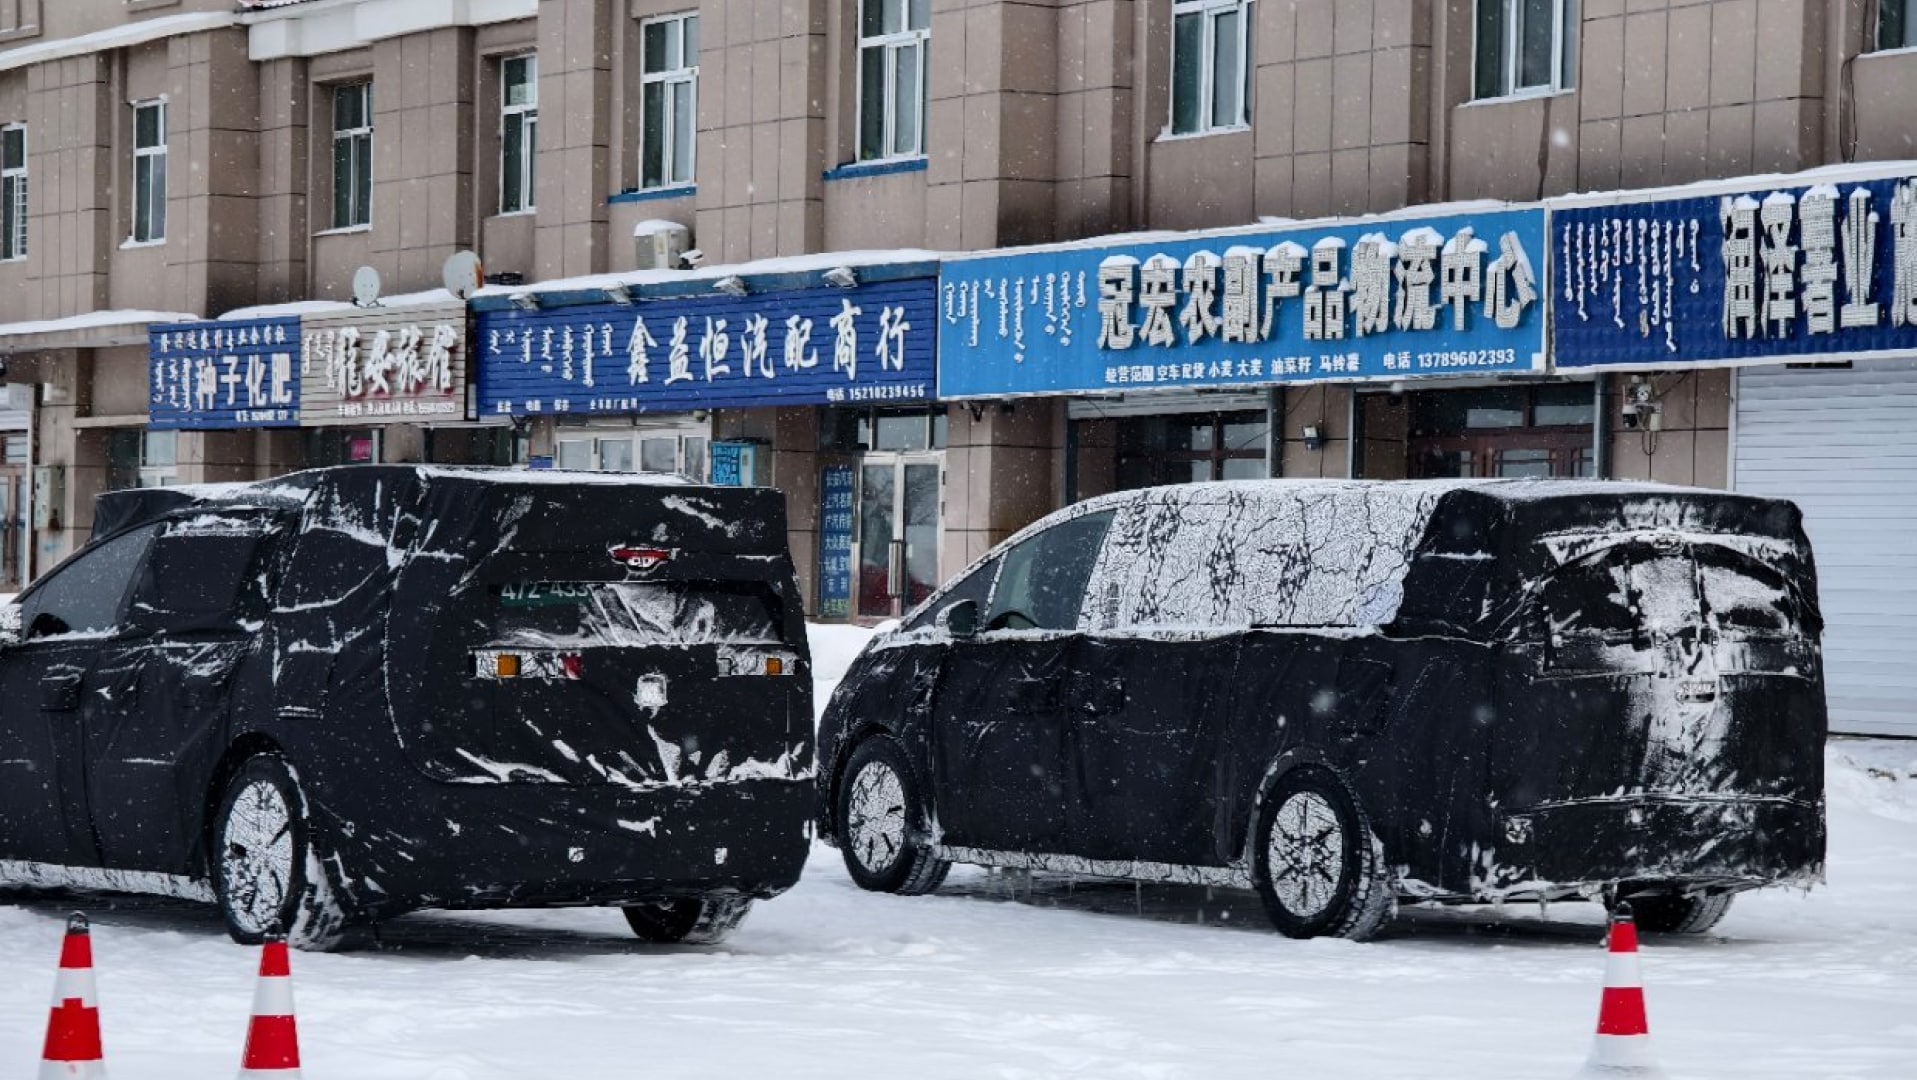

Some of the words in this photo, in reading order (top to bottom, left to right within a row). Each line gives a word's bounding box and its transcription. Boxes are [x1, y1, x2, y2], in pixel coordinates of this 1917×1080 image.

[1097, 228, 1537, 350] 冠宏农副产品物流中心
[626, 299, 910, 386] 鑫益恒汽配商行
[1105, 365, 1155, 383] 经营范围
[1208, 359, 1233, 379] 小麦
[1237, 358, 1263, 377] 大麦
[1383, 351, 1412, 370] 电话
[1417, 348, 1515, 369] 13789602393
[195, 353, 293, 410] 种子化肥
